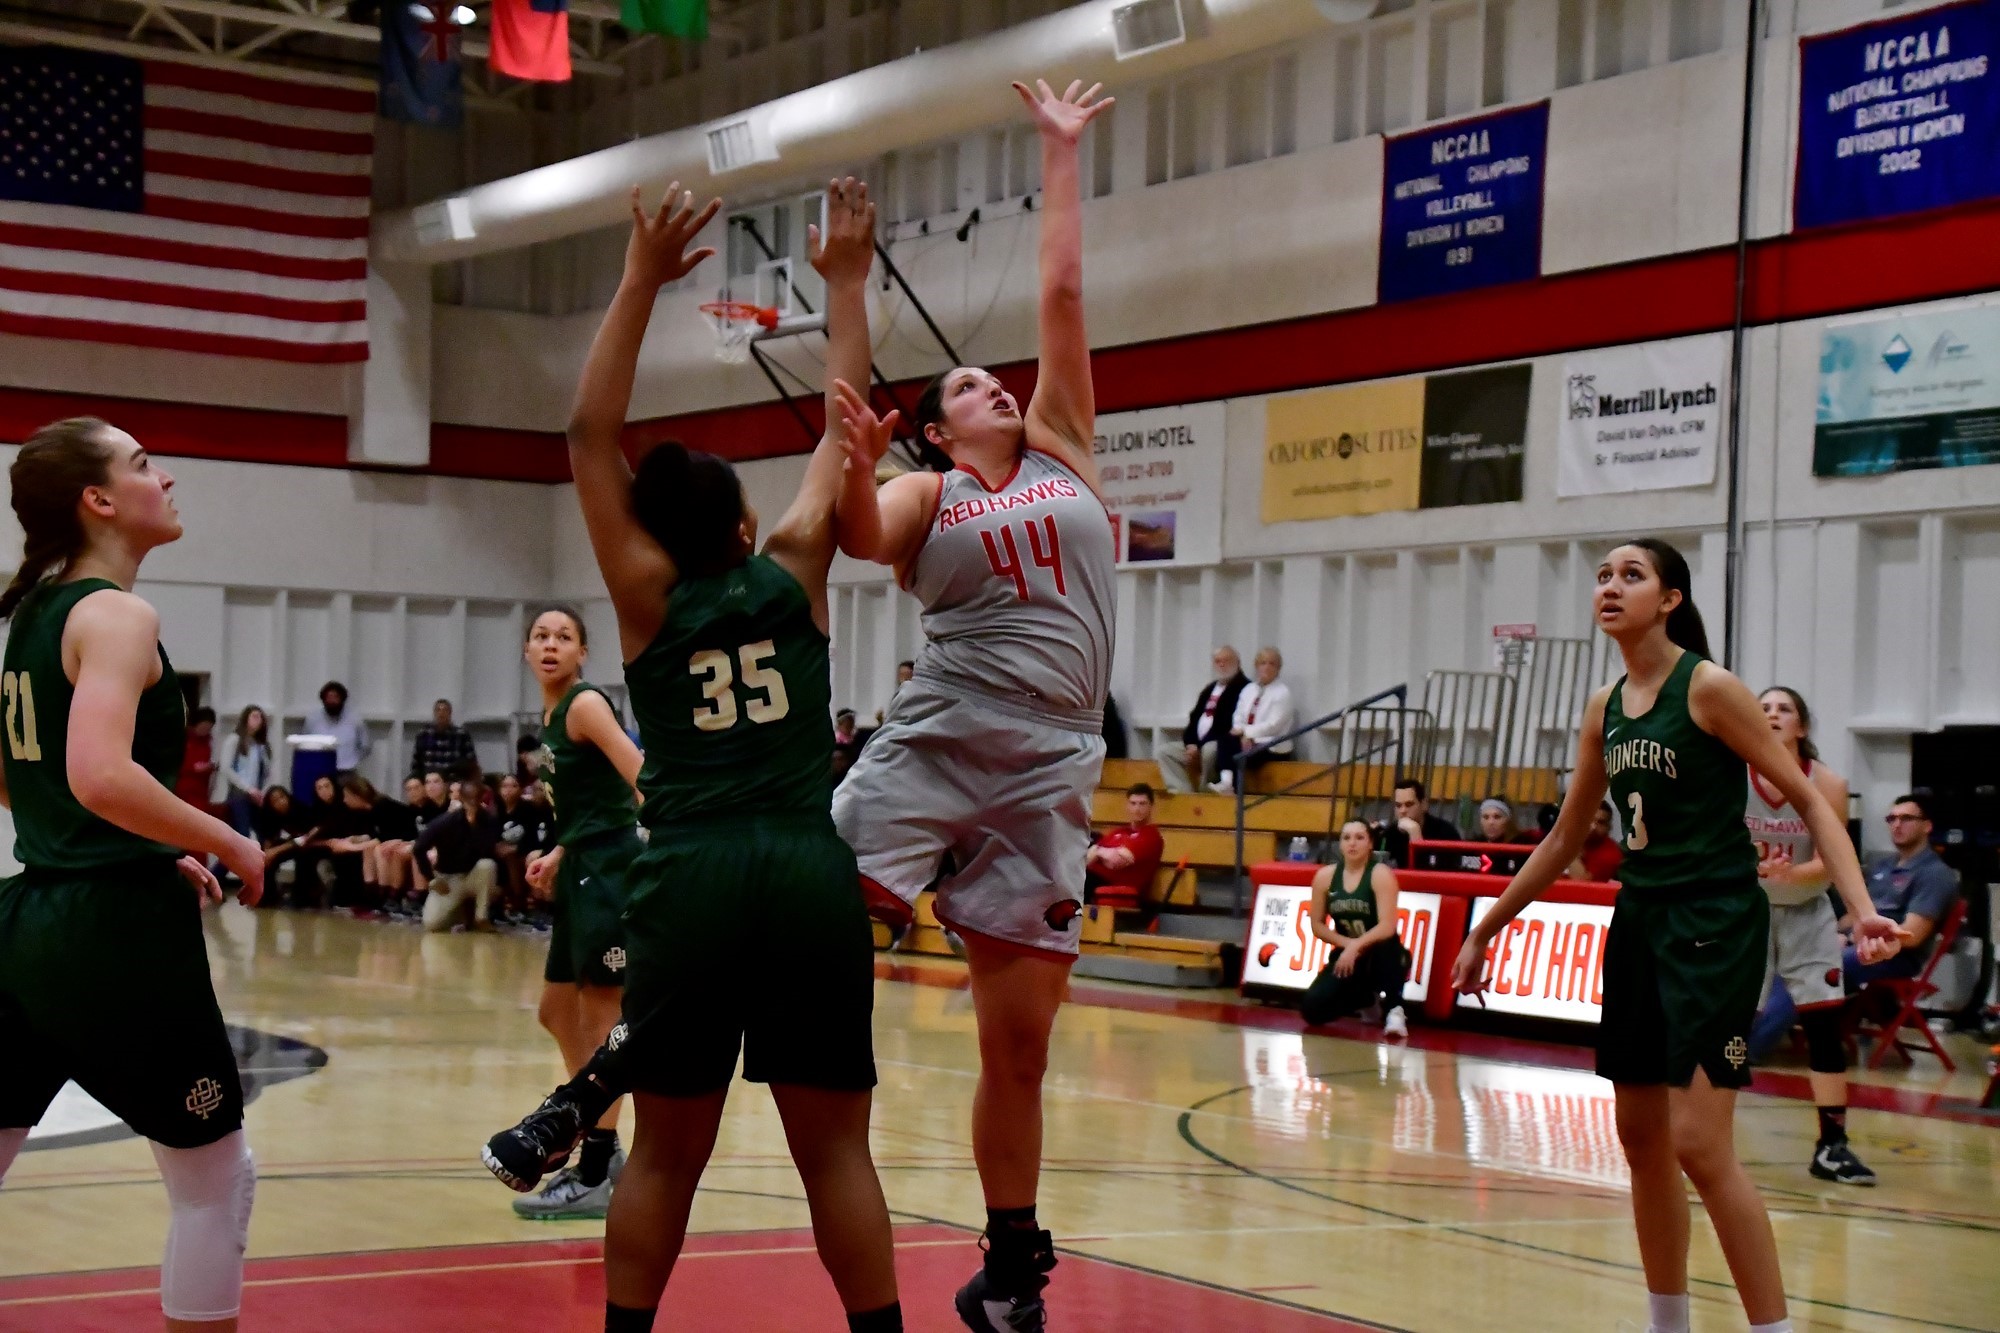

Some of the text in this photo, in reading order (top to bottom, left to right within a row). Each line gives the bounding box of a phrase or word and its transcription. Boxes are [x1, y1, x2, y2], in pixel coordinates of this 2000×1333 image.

[1864, 26, 1950, 72] NCCAA
[1827, 55, 1988, 113] NATIONAL CHAMPIONS
[1855, 90, 1949, 129] BASKETBALL
[1431, 129, 1490, 164] NCCAA
[1836, 127, 1897, 159] DIVISION
[1911, 113, 1966, 144] WOMEN
[1879, 149, 1921, 175] 2002
[1598, 381, 1717, 417] Merrill Lynch
[1094, 425, 1195, 454] ED LION HOTEL
[939, 499, 986, 533] RED
[987, 479, 1079, 513] HAWKS
[979, 513, 1068, 601] 44
[688, 638, 790, 732] 35
[3, 671, 41, 761] 21
[1626, 791, 1649, 850] 3
